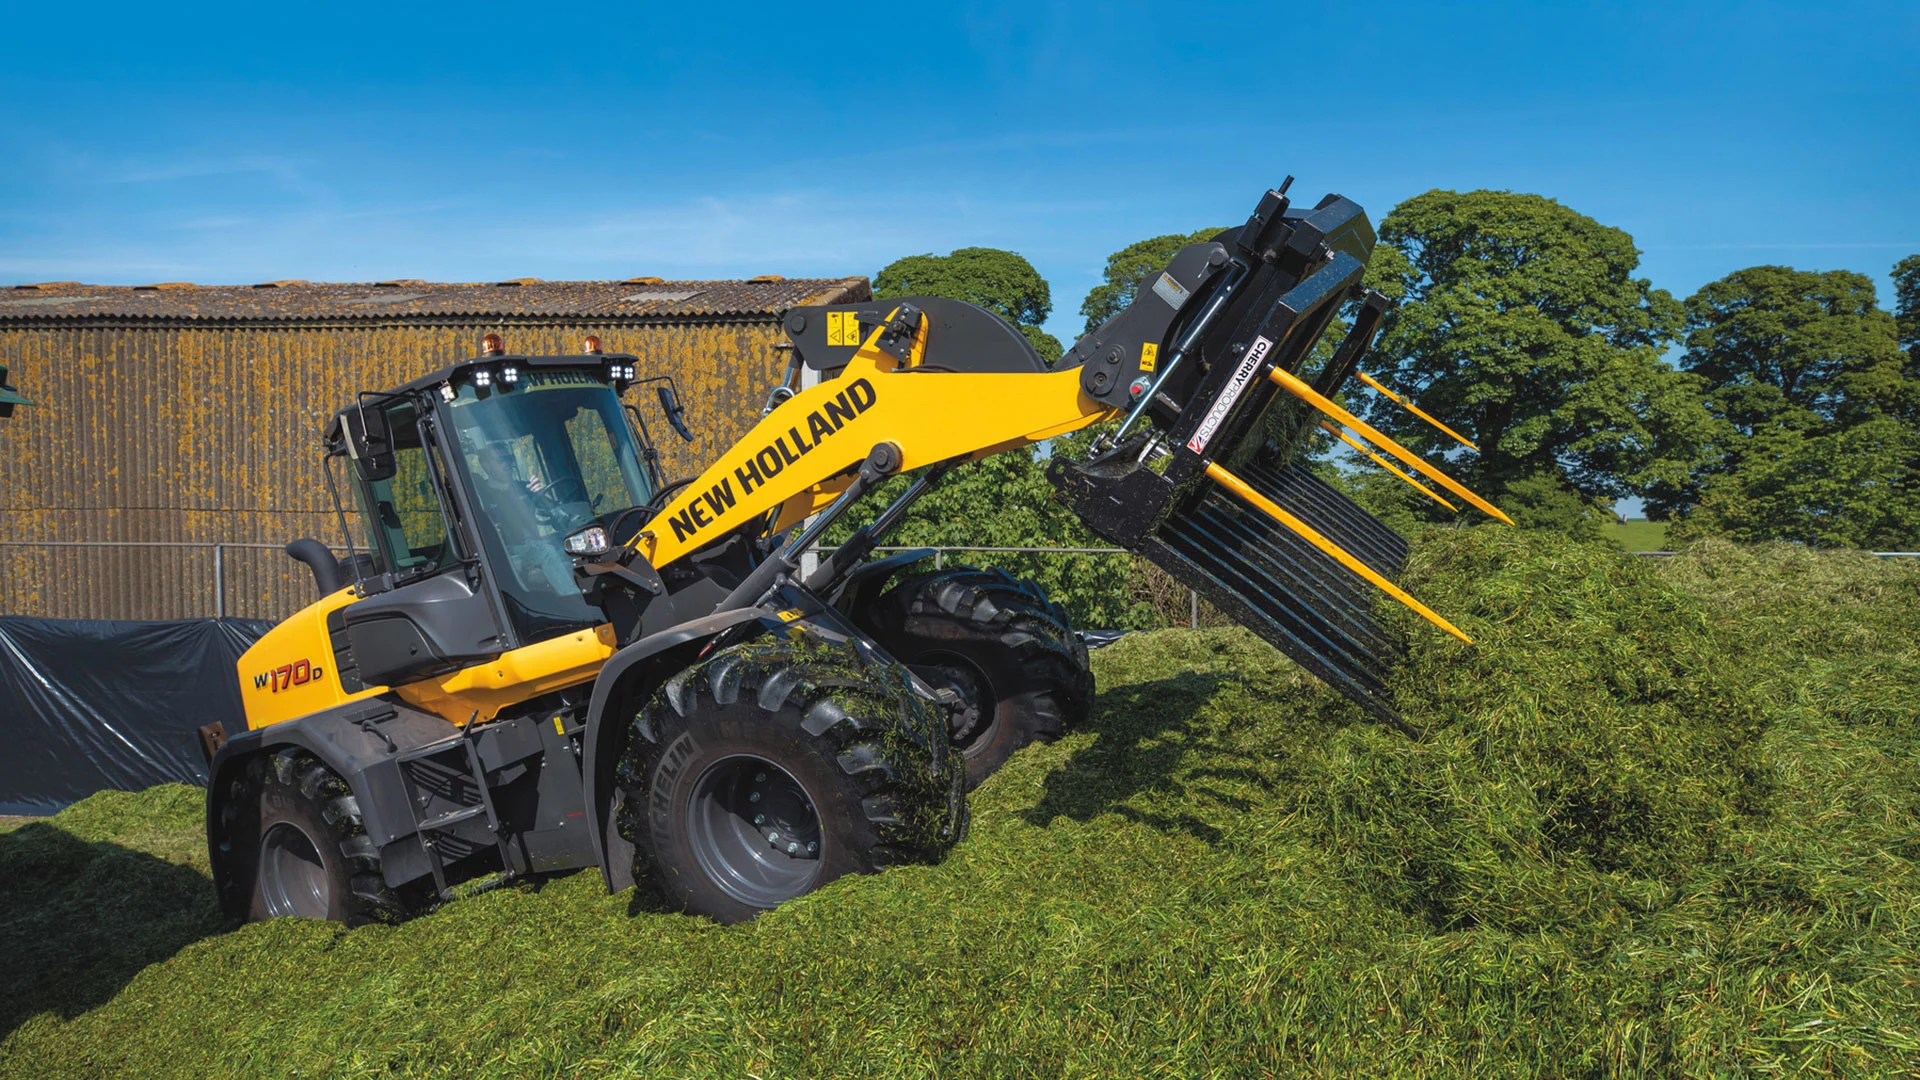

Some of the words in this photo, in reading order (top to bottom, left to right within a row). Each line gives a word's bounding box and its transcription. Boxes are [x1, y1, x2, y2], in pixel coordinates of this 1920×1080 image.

[667, 476, 737, 544] NEW
[733, 377, 877, 496] HOLLAND
[652, 736, 697, 857] ICHELIN
